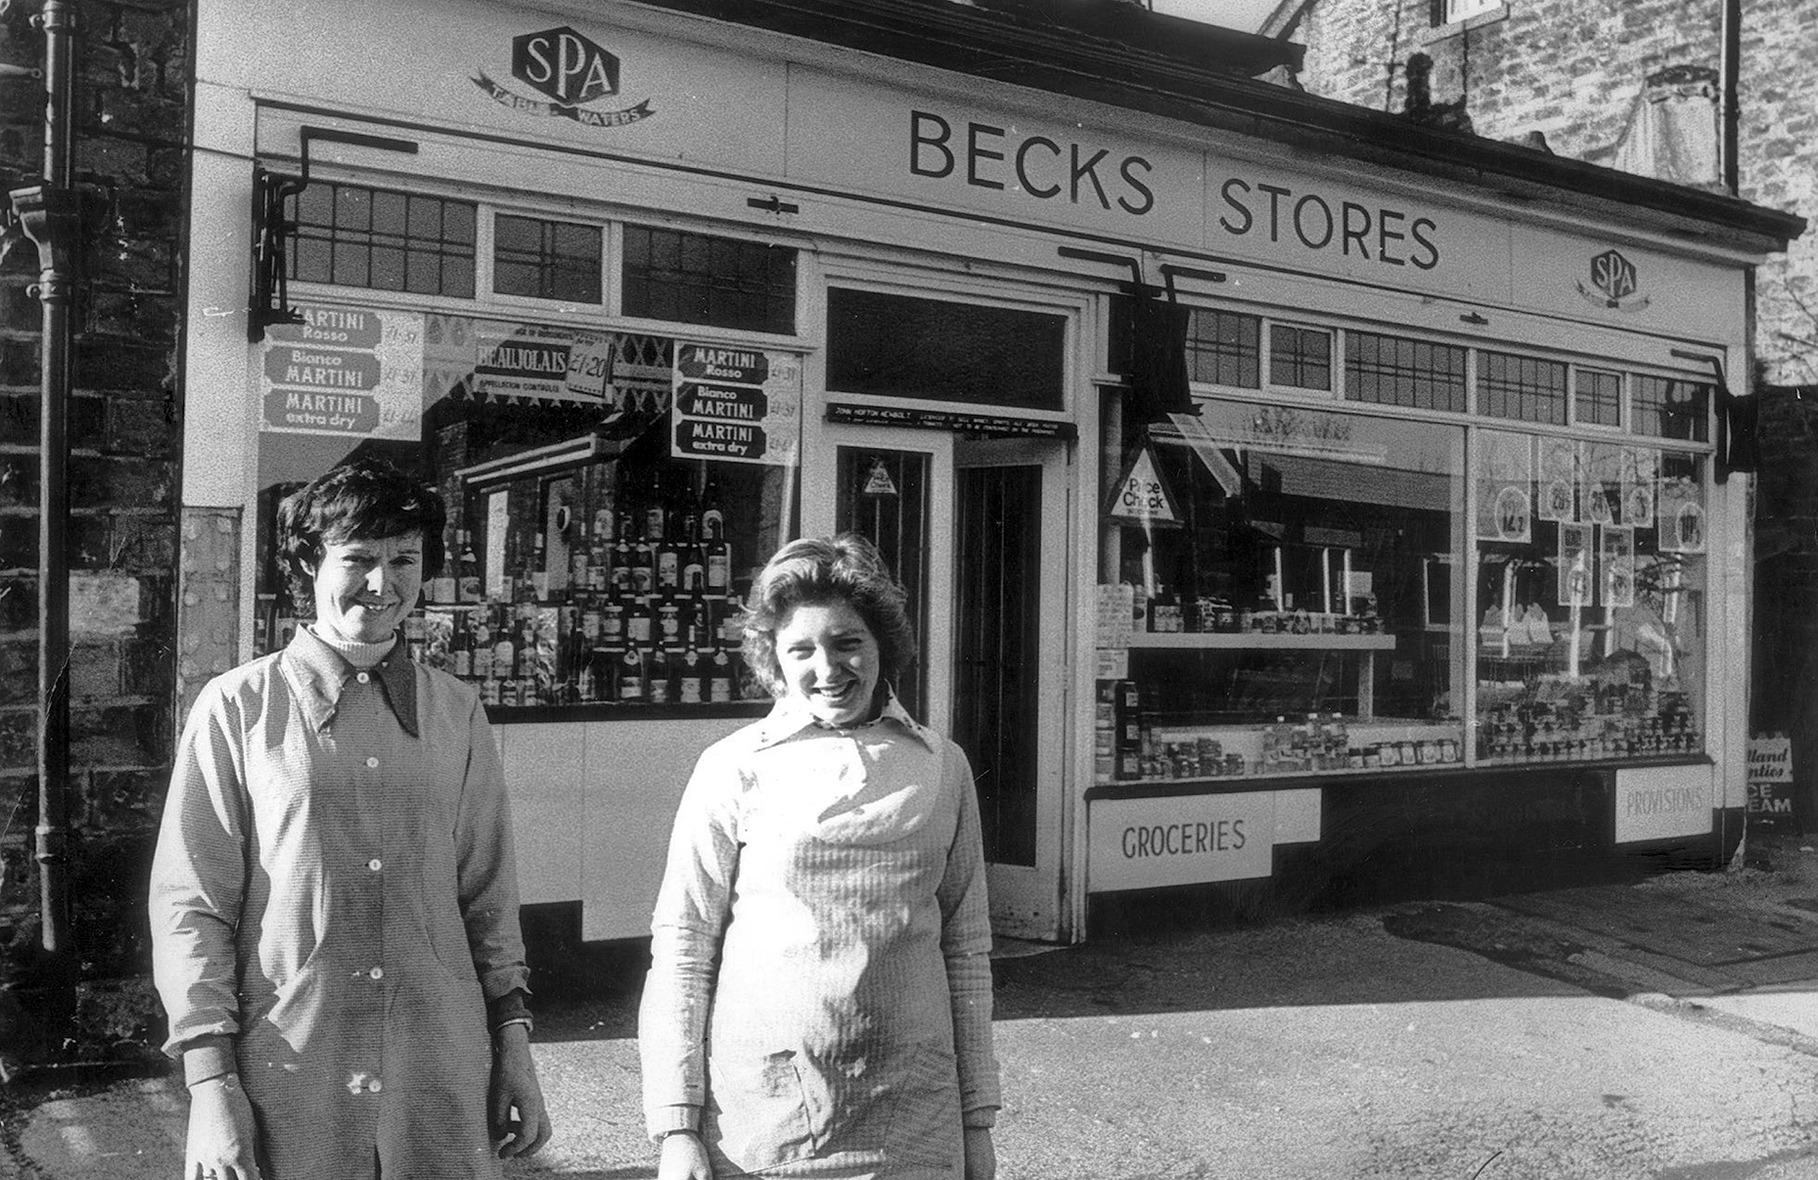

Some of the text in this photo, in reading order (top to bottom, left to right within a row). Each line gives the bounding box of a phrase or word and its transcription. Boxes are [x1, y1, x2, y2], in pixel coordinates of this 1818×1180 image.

[525, 33, 613, 99] SPA
[577, 107, 642, 126] WATERS
[909, 109, 1440, 270] BECKS STORES
[1596, 253, 1635, 297] SPA
[293, 306, 364, 331] ARTINI
[302, 324, 348, 342] Rosso
[291, 349, 342, 366] Bianco
[477, 346, 567, 374] BEAUJOLAIS
[693, 347, 756, 369] MARTINI
[285, 365, 363, 388] MARTINI
[705, 364, 743, 379] Rosso
[697, 385, 737, 400] Bianco
[285, 393, 363, 414] MARTINI
[692, 399, 754, 419] MARTINI
[285, 412, 356, 430] extra dry
[692, 422, 753, 442] MARTINI
[692, 441, 748, 455] extra dry
[1129, 478, 1161, 494] Pce
[1123, 491, 1164, 509] Chck
[1626, 786, 1703, 817] PROVISIONS
[1748, 798, 1792, 813] EAM
[1122, 819, 1246, 859] GROCERIES
